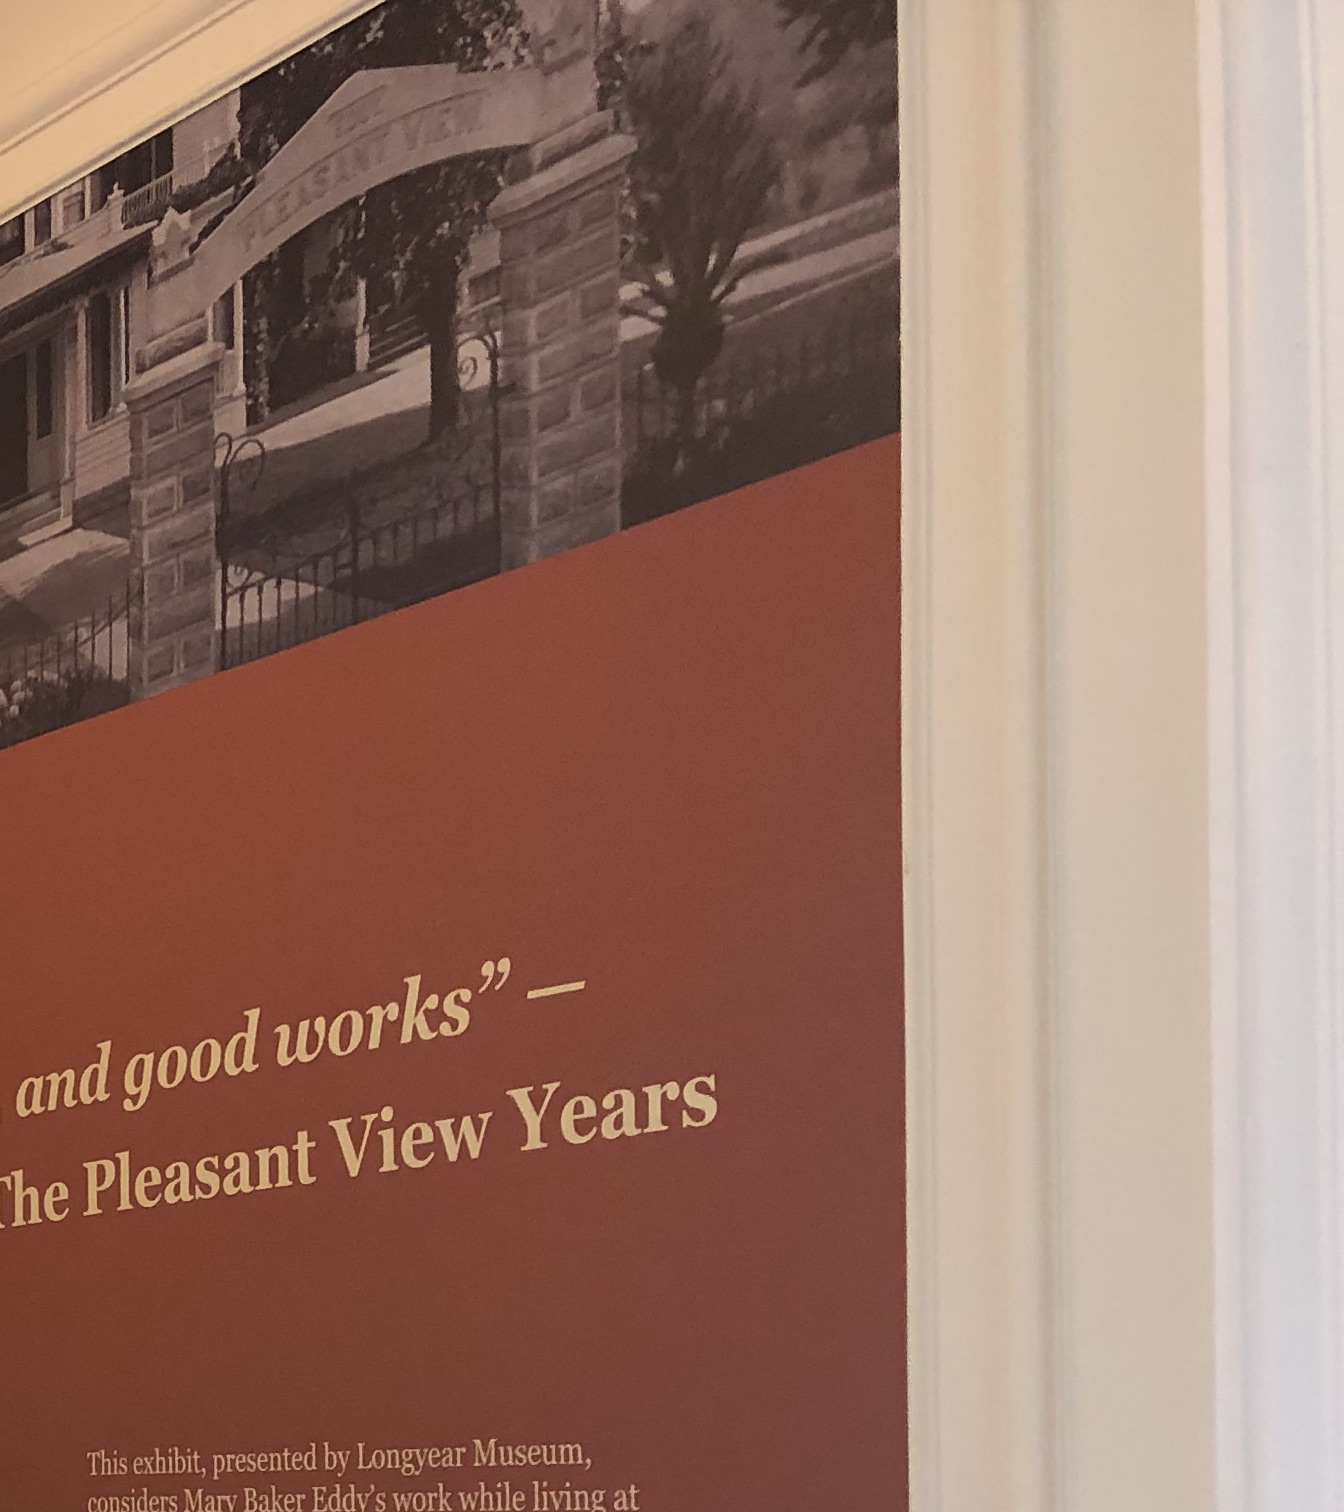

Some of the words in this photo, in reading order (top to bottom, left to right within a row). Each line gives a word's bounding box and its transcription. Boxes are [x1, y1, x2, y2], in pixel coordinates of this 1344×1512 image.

[15, 1041, 112, 1118] and
[123, 1007, 261, 1112] good
[274, 956, 512, 1067] works”
[82, 1129, 317, 1217] Pleasant
[328, 1105, 493, 1178] View
[506, 1073, 718, 1152] Years
[87, 1450, 128, 1476] This
[132, 1448, 207, 1479] exhibit,
[212, 1445, 317, 1479] presented
[324, 1443, 350, 1476] by
[357, 1443, 466, 1476] Longyear
[472, 1439, 592, 1471] Museum,
[392, 1486, 452, 1512] work
[458, 1484, 526, 1512] while
[613, 1487, 640, 1511] at
